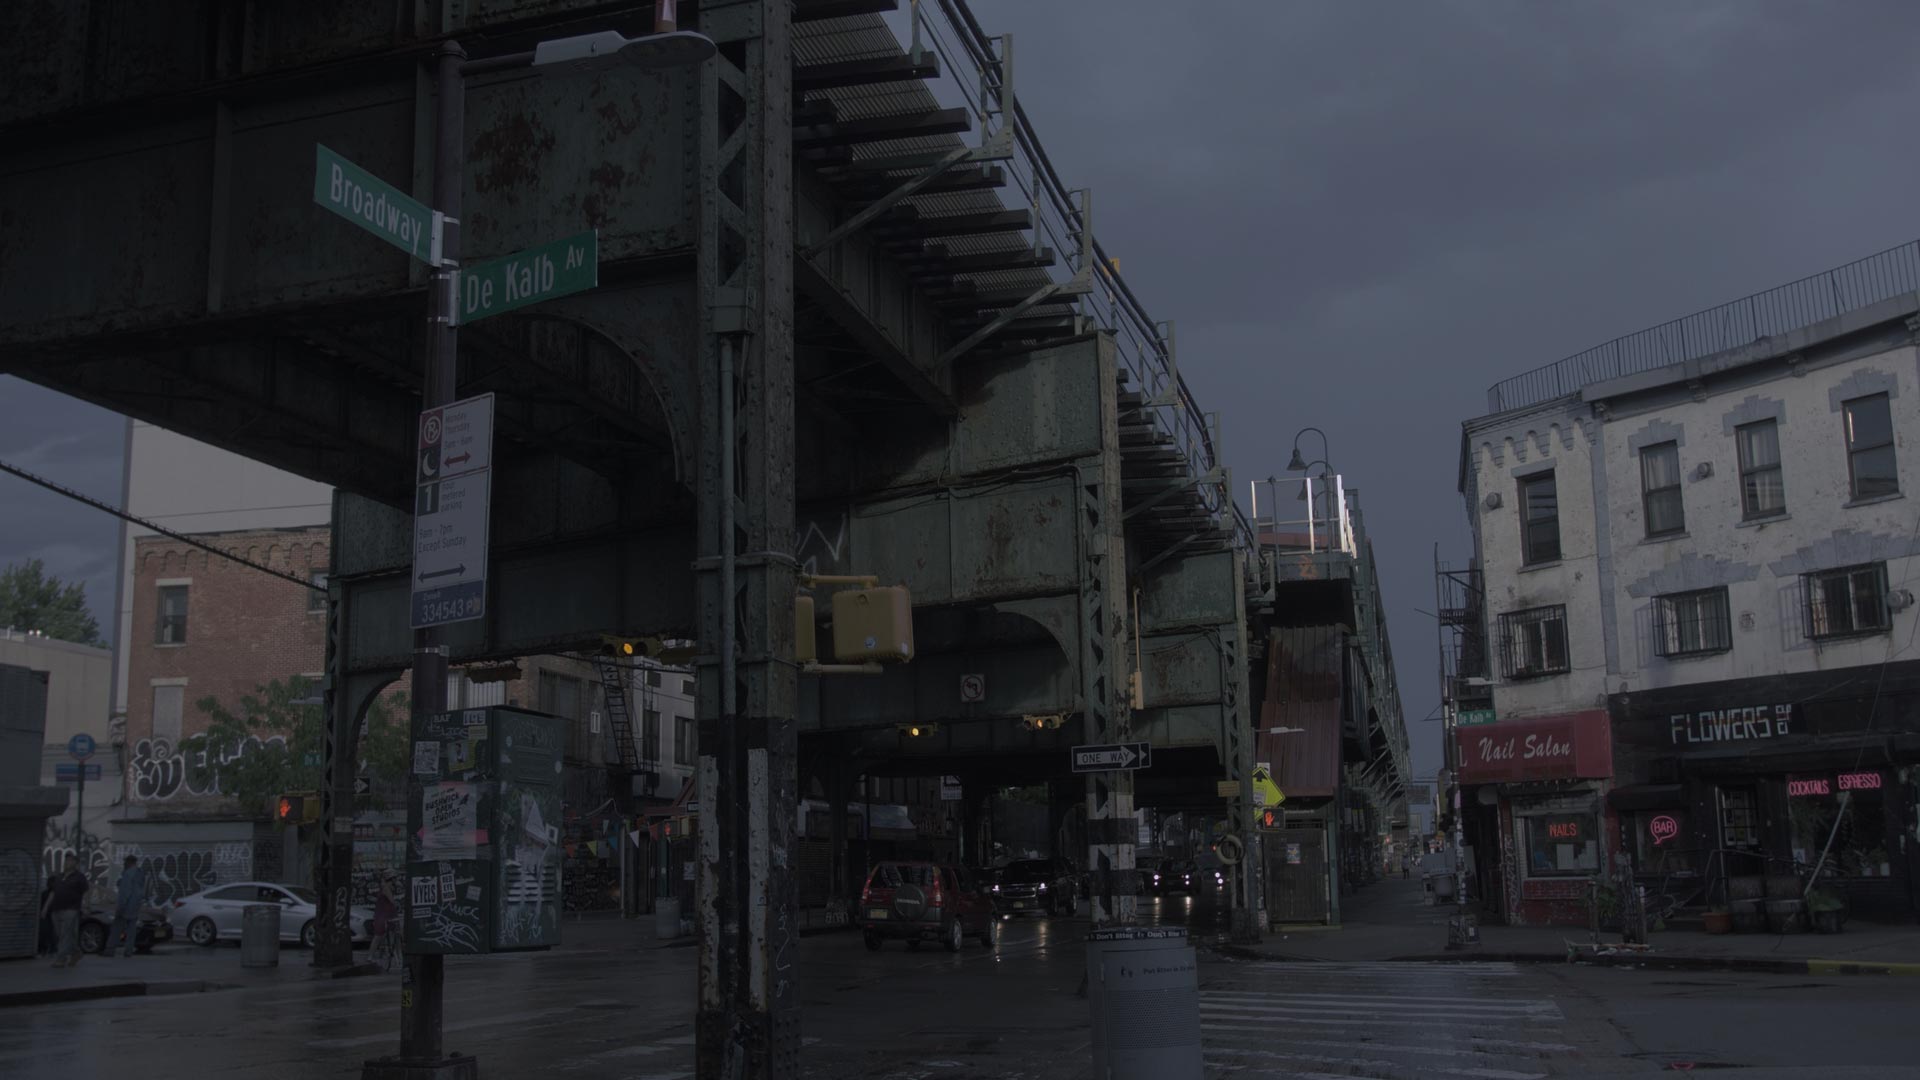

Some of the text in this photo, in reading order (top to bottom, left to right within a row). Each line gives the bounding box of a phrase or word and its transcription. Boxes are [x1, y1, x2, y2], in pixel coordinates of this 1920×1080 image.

[330, 162, 422, 255] Broadway
[466, 244, 585, 314] De Kalb Av
[418, 535, 468, 553] Except Sunday
[421, 598, 464, 624] 334543
[1458, 714, 1467, 724] De
[1469, 713, 1484, 724] Kalb
[1671, 705, 1771, 744] FLOWERS
[1479, 737, 1515, 763] Nail
[1523, 734, 1570, 759] Salon
[1082, 751, 1129, 764] ONE WAY
[1788, 779, 1830, 796] COCKTAILS
[1838, 773, 1881, 790] ESPRESSO
[425, 792, 459, 811] BUSHWICK
[432, 807, 460, 824] STUDIOS
[1549, 822, 1577, 838] NAILS
[1653, 821, 1673, 834] BAR
